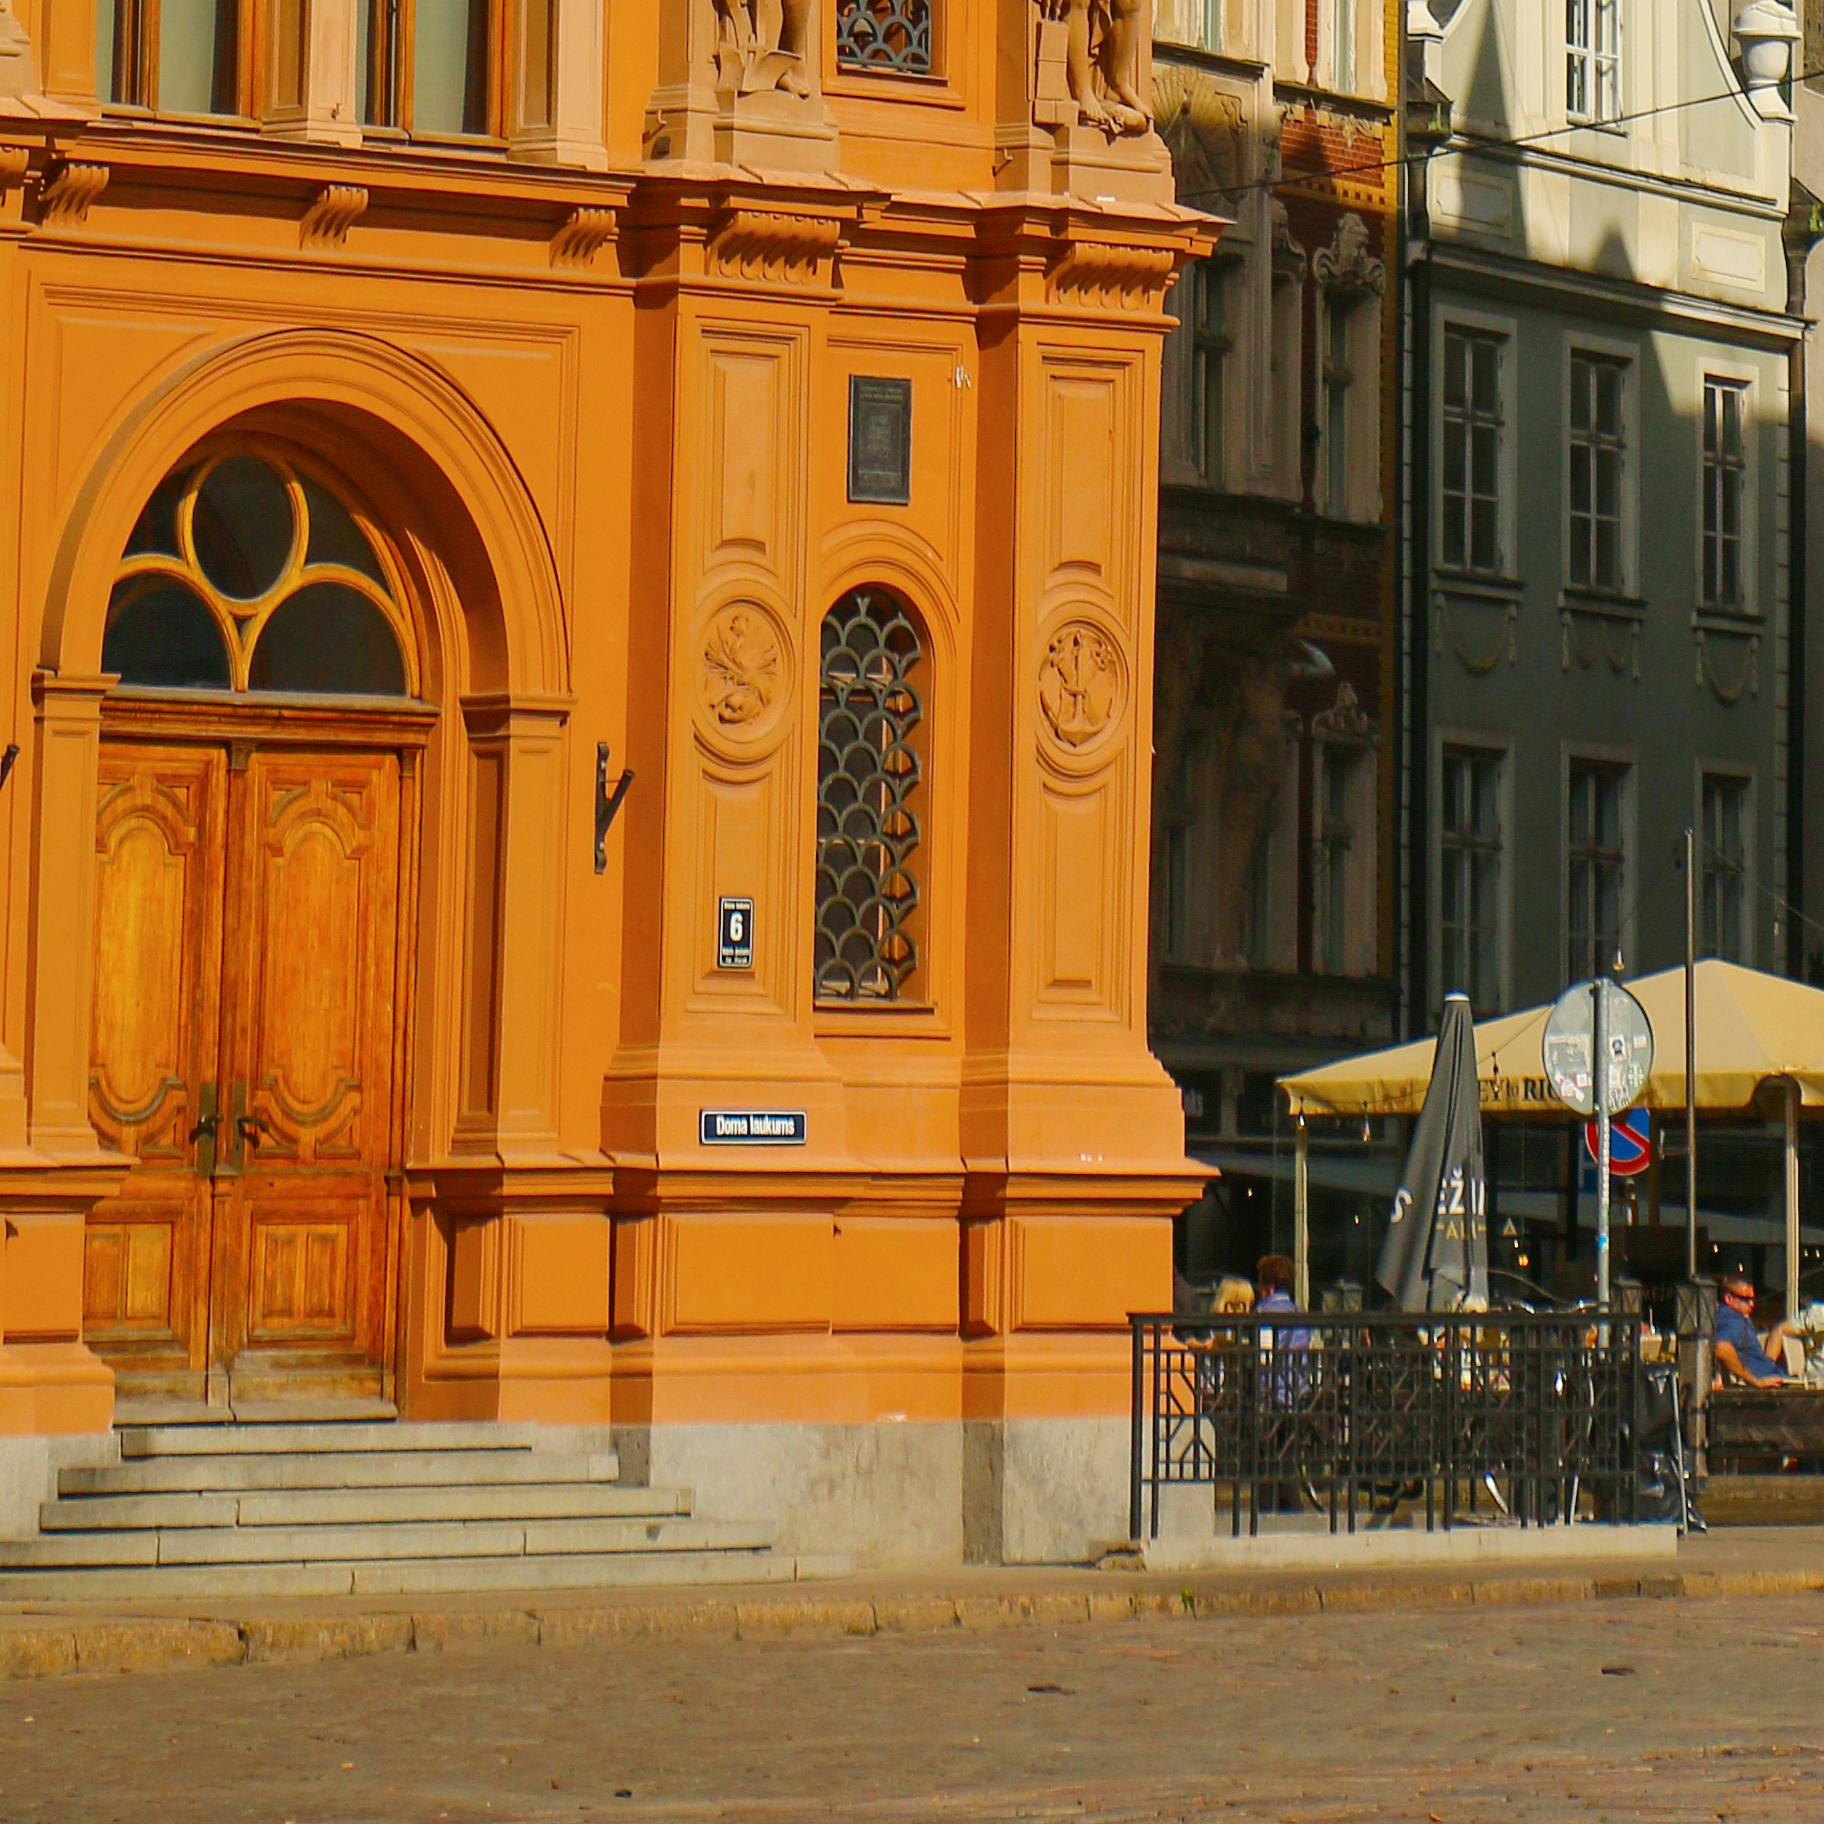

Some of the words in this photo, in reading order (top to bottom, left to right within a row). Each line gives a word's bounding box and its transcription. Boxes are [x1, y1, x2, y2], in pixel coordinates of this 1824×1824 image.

[730, 911, 743, 942] 6
[716, 1115, 748, 1136] Doma
[750, 1114, 795, 1136] laukums
